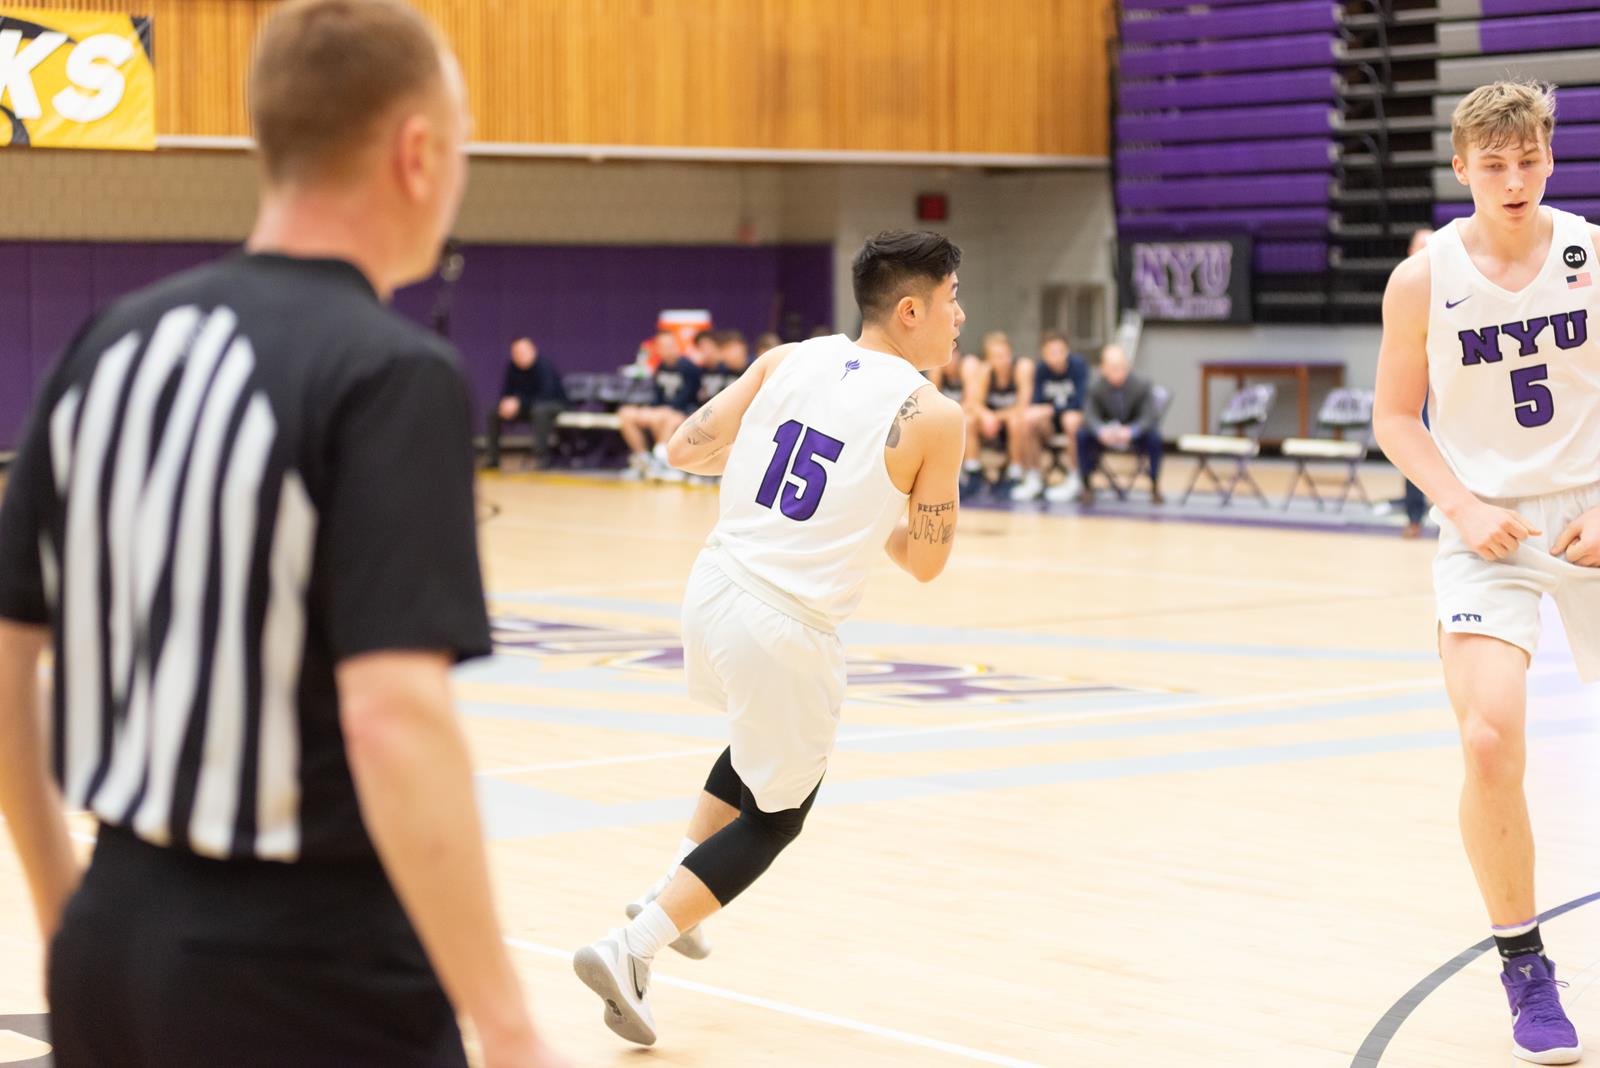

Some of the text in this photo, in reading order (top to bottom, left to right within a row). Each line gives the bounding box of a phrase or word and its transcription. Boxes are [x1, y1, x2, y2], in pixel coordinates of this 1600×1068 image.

[1133, 242, 1233, 305] NYU
[1565, 250, 1585, 262] Cal
[1458, 309, 1588, 366] NYU
[1510, 363, 1555, 428] 5
[755, 419, 845, 522] 15
[1452, 613, 1482, 622] NYU
